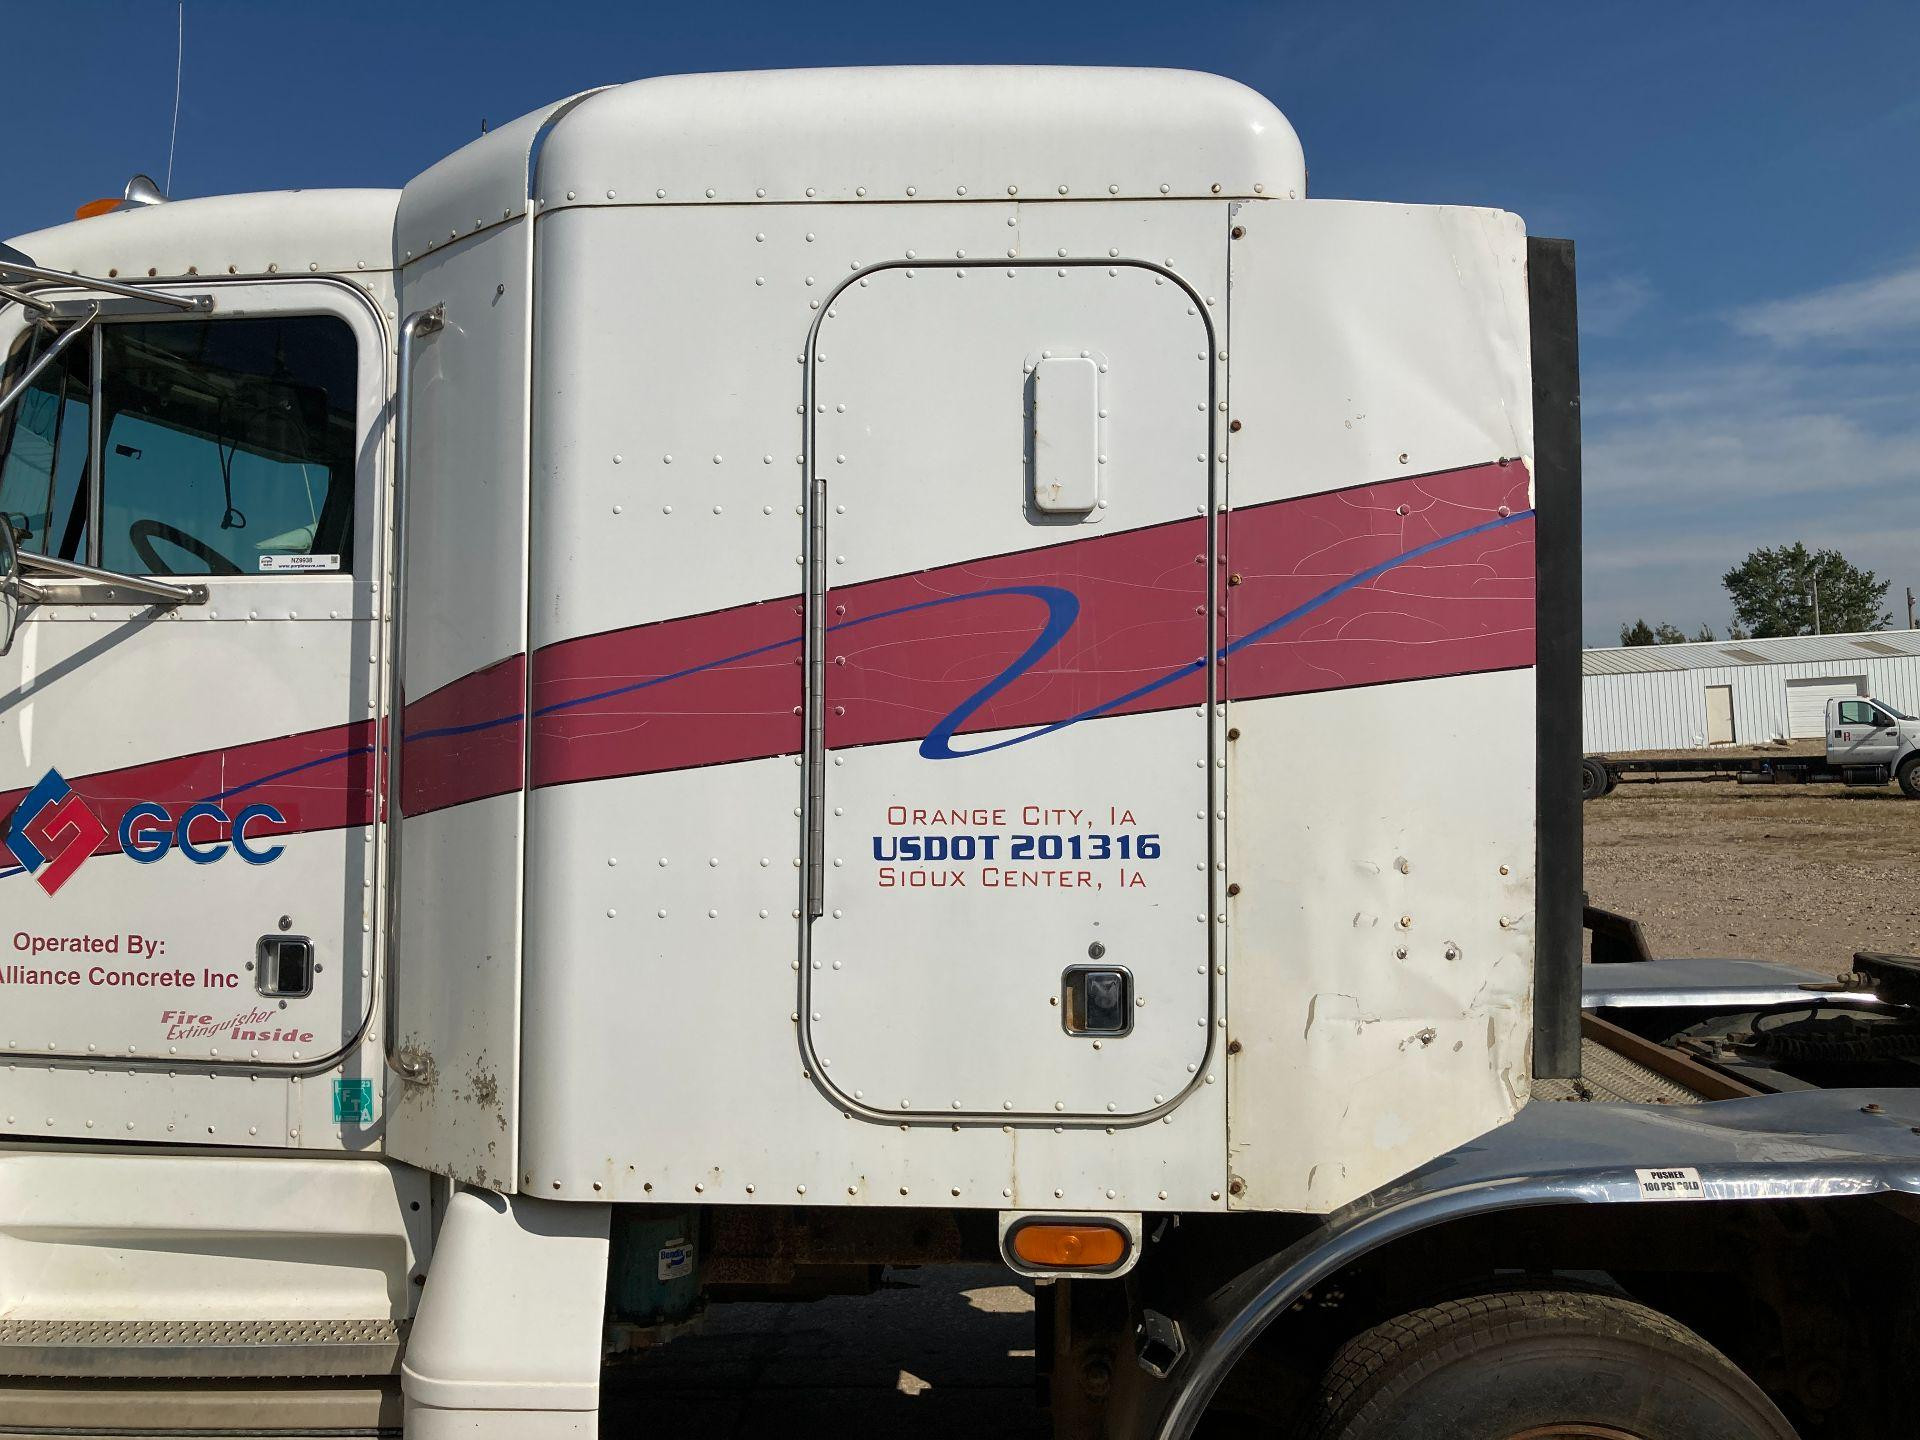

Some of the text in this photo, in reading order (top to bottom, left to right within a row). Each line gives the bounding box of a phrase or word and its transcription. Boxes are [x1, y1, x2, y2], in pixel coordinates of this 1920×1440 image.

[118, 802, 287, 865] GCC
[873, 834, 1161, 861] USDOT 201316
[13, 932, 165, 959] Operated By:
[88, 967, 195, 988] Concrete
[203, 969, 239, 988] Inc
[161, 1011, 213, 1025] Fire
[167, 1006, 276, 1040] Extinguisher
[231, 1027, 314, 1043] Inside
[1651, 1171, 1685, 1179] PUSHER
[1643, 1183, 1660, 1191] 100
[1662, 1182, 1676, 1191] PSI
